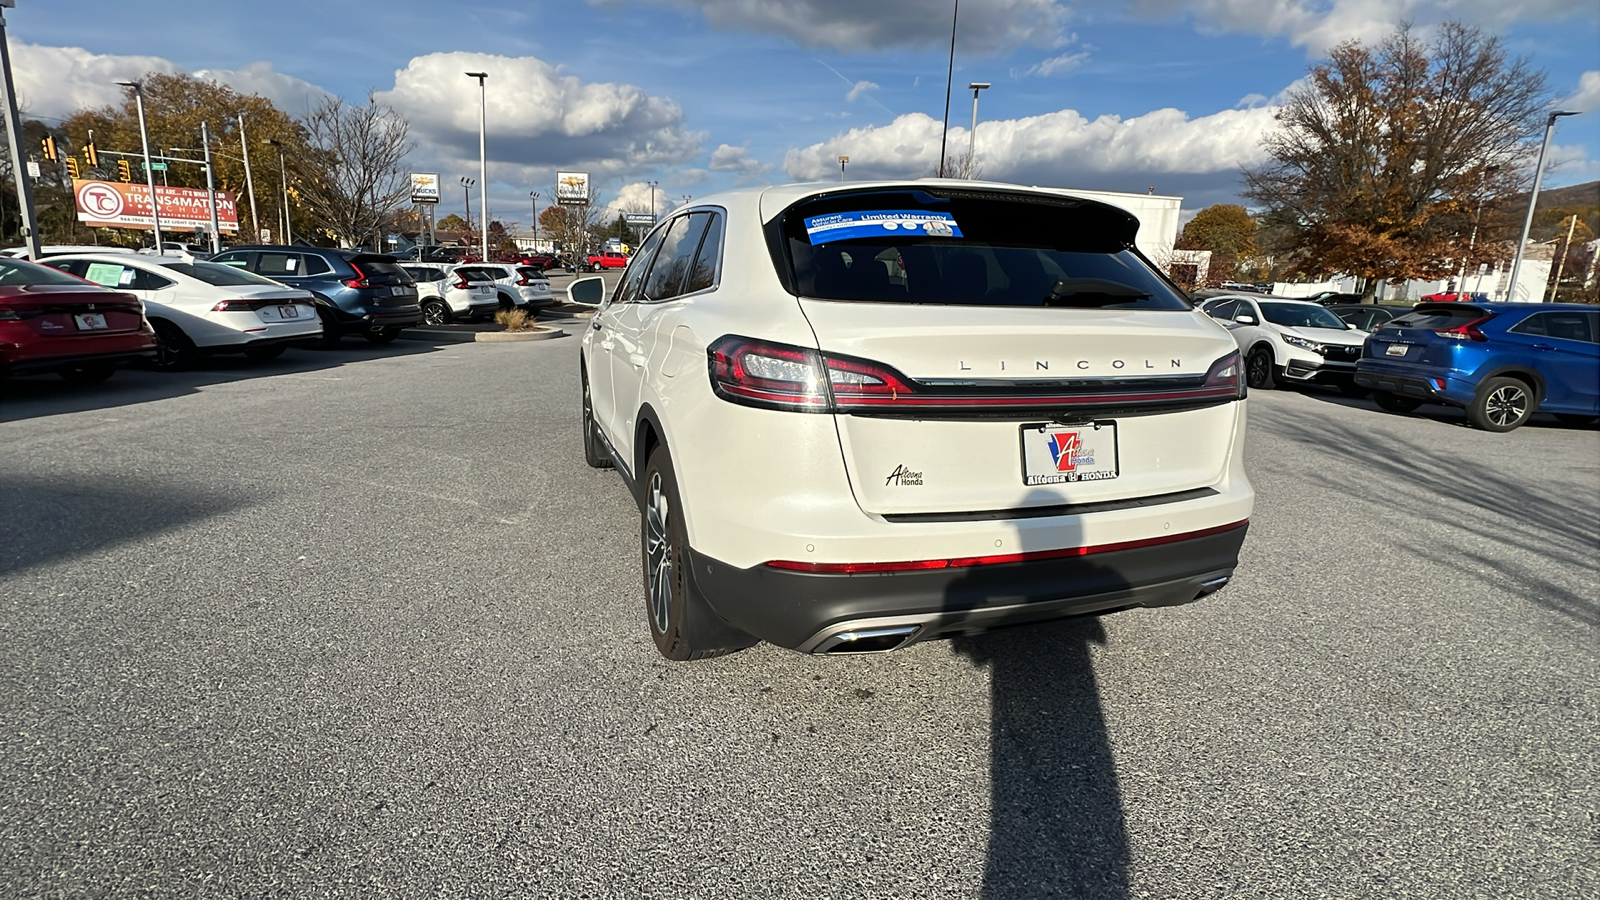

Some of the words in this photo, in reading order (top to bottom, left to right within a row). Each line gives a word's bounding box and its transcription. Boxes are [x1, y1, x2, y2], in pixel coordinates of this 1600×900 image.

[193, 191, 208, 199] WHAT
[166, 205, 234, 216] CHURCH
[811, 214, 843, 223] Assurant
[861, 213, 899, 221] Limited
[900, 213, 947, 221] Warranty
[960, 359, 1182, 371] LINCOLN
[1070, 457, 1095, 465] Honda
[1027, 474, 1066, 485] Altoona
[1081, 471, 1118, 481] HONDA
